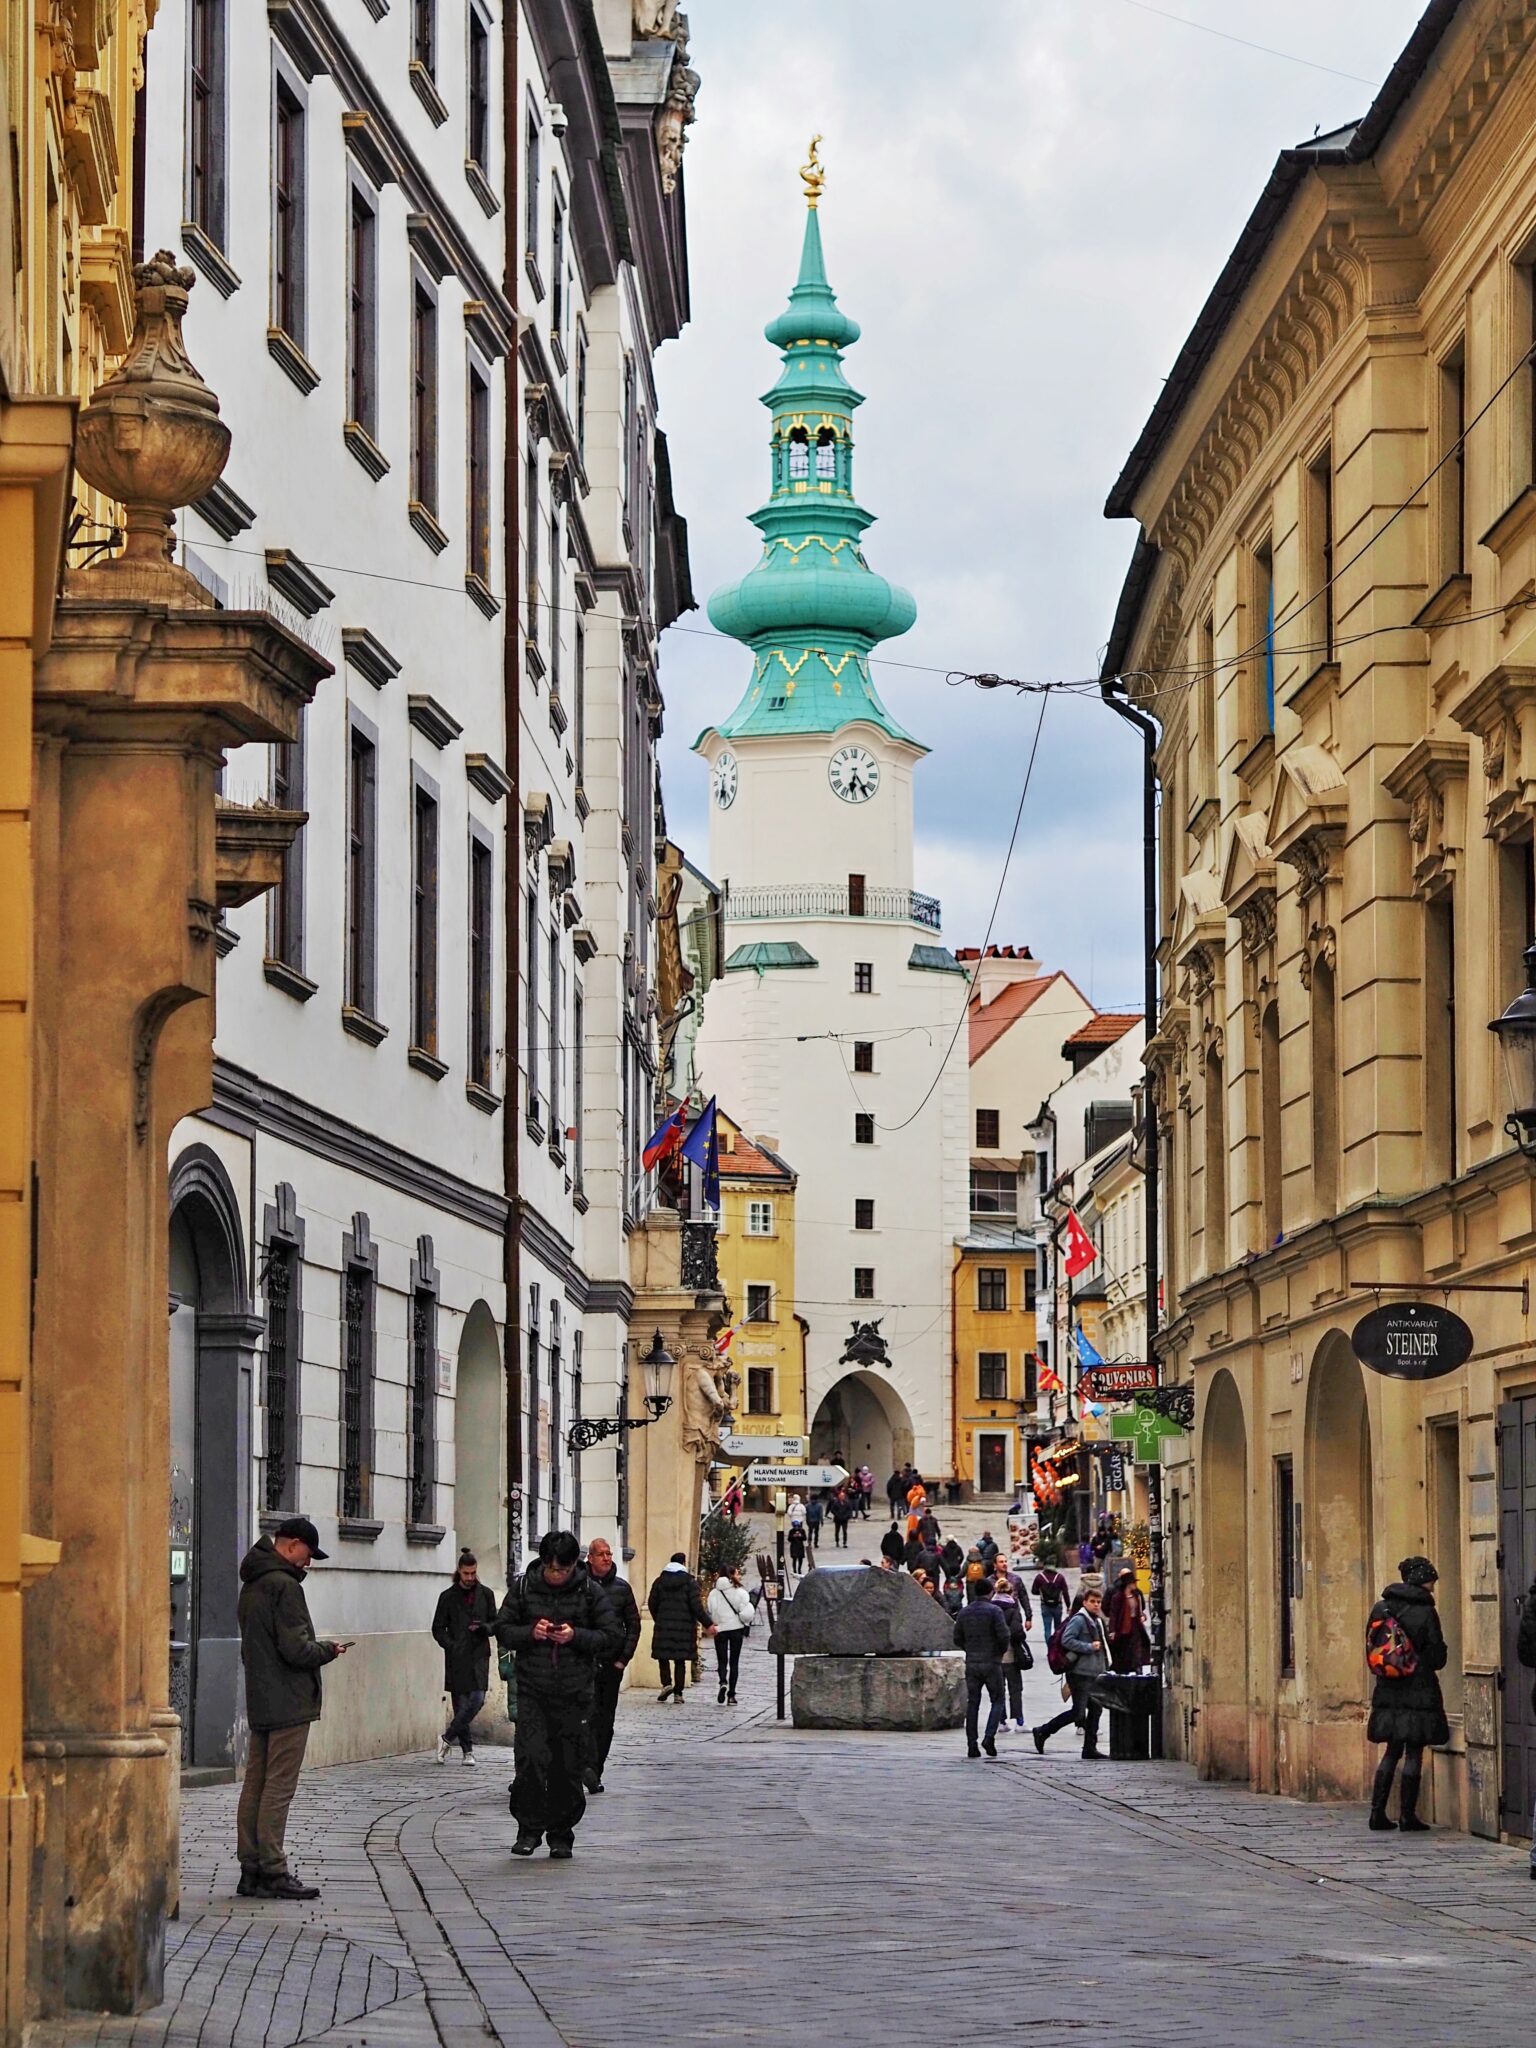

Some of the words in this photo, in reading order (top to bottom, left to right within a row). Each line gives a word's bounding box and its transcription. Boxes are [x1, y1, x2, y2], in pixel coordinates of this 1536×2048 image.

[1387, 1318, 1438, 1327] ANTIKVARIÁT
[1386, 1332, 1439, 1356] STEINER
[1111, 1455, 1123, 1490] CIGÁR
